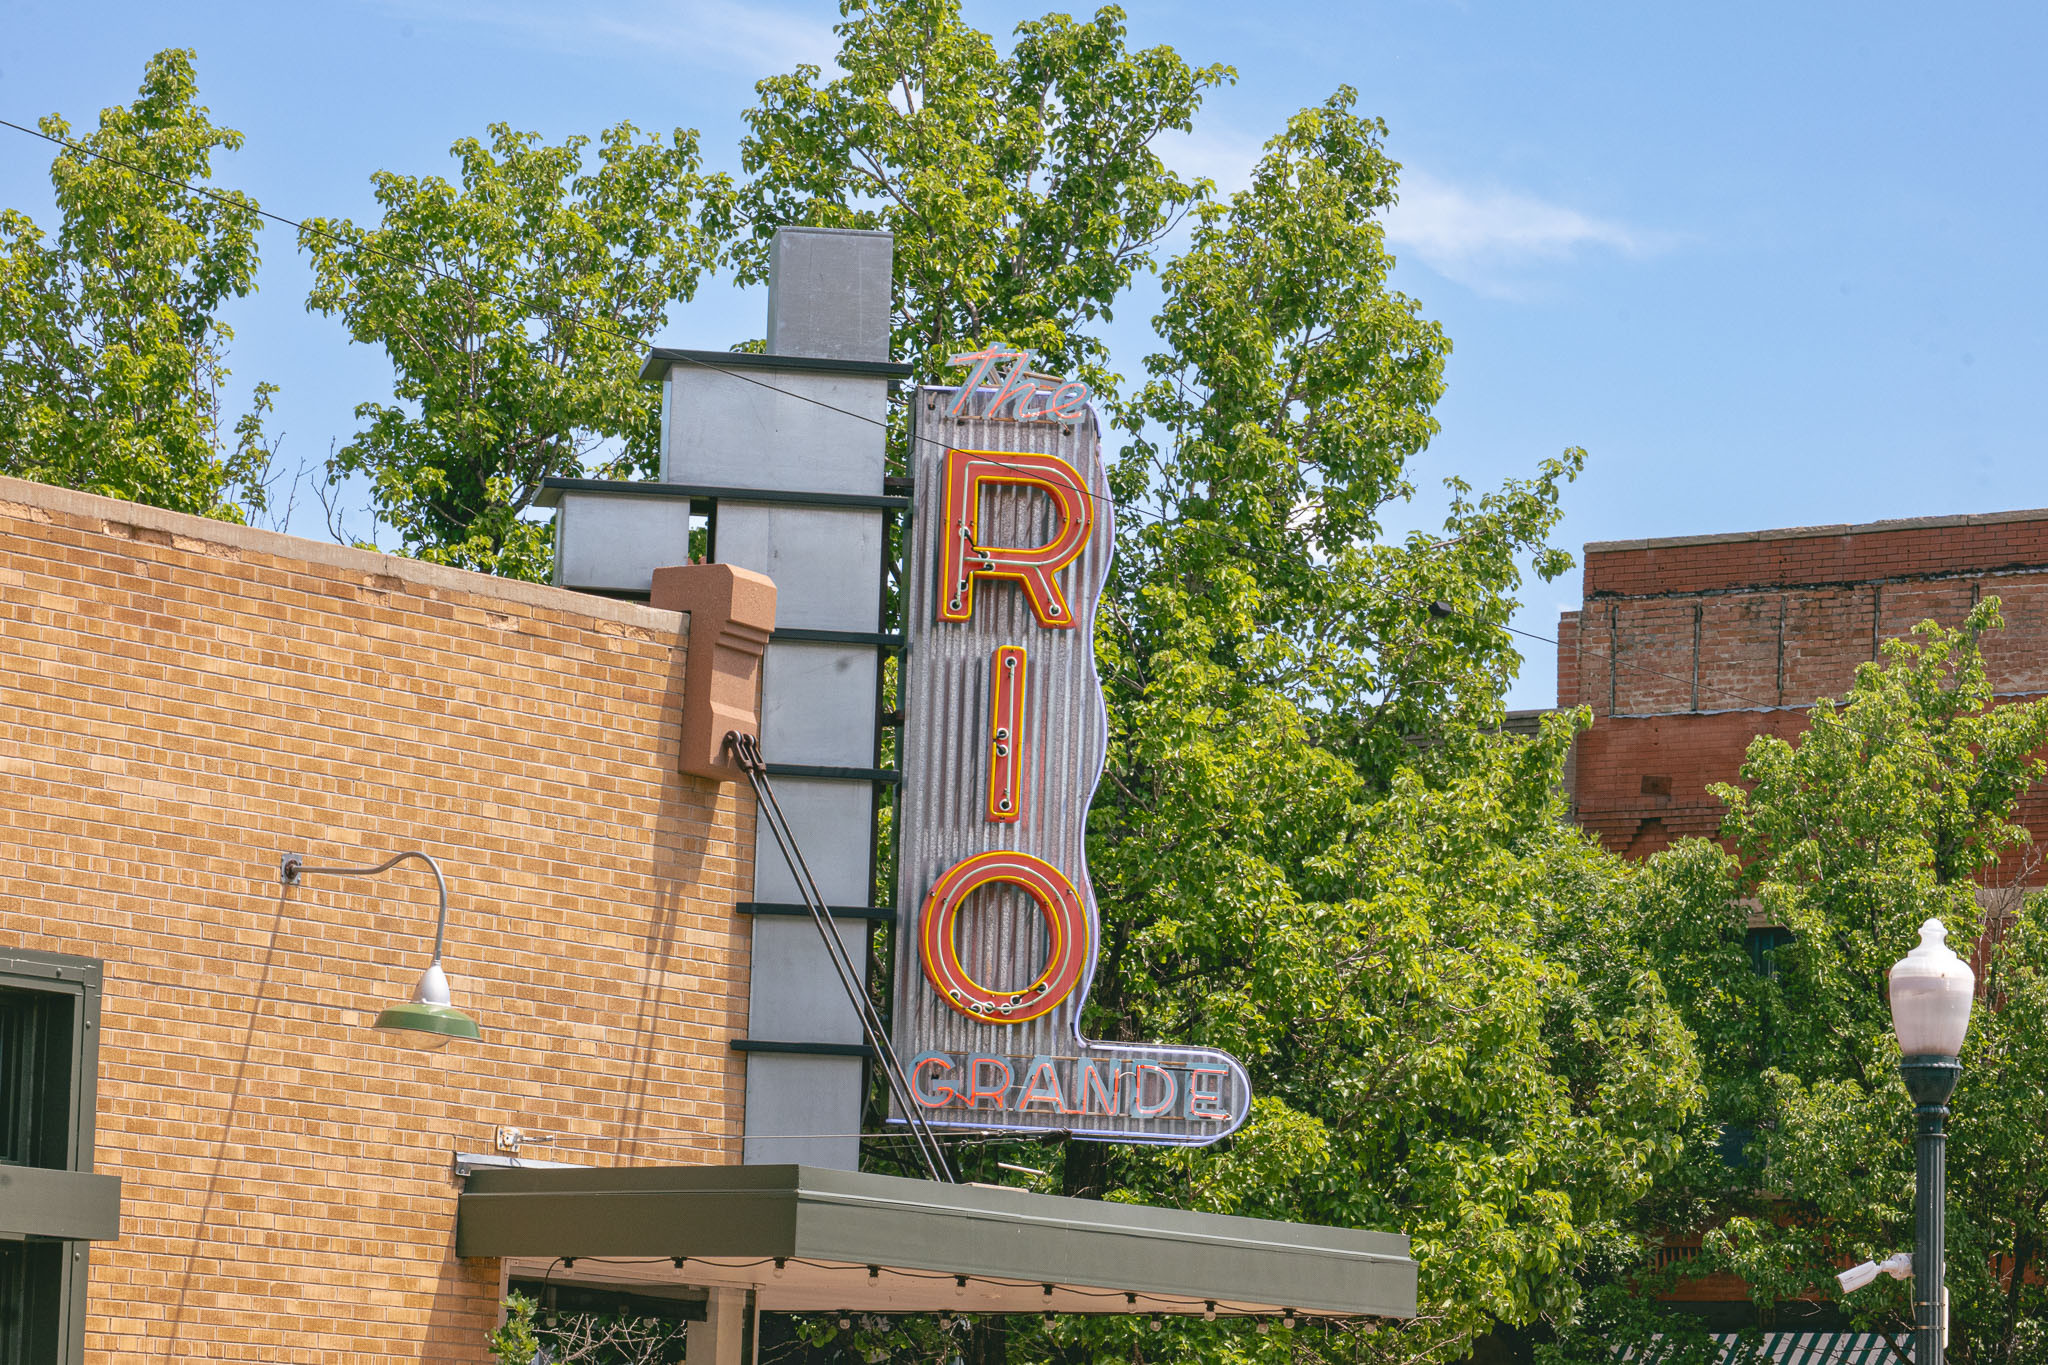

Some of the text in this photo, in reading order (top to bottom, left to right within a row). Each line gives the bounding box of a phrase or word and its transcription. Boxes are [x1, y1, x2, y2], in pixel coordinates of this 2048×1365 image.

[945, 341, 1092, 424] The
[918, 449, 1093, 1024] RIO
[907, 1050, 1229, 1121] GRANDE
